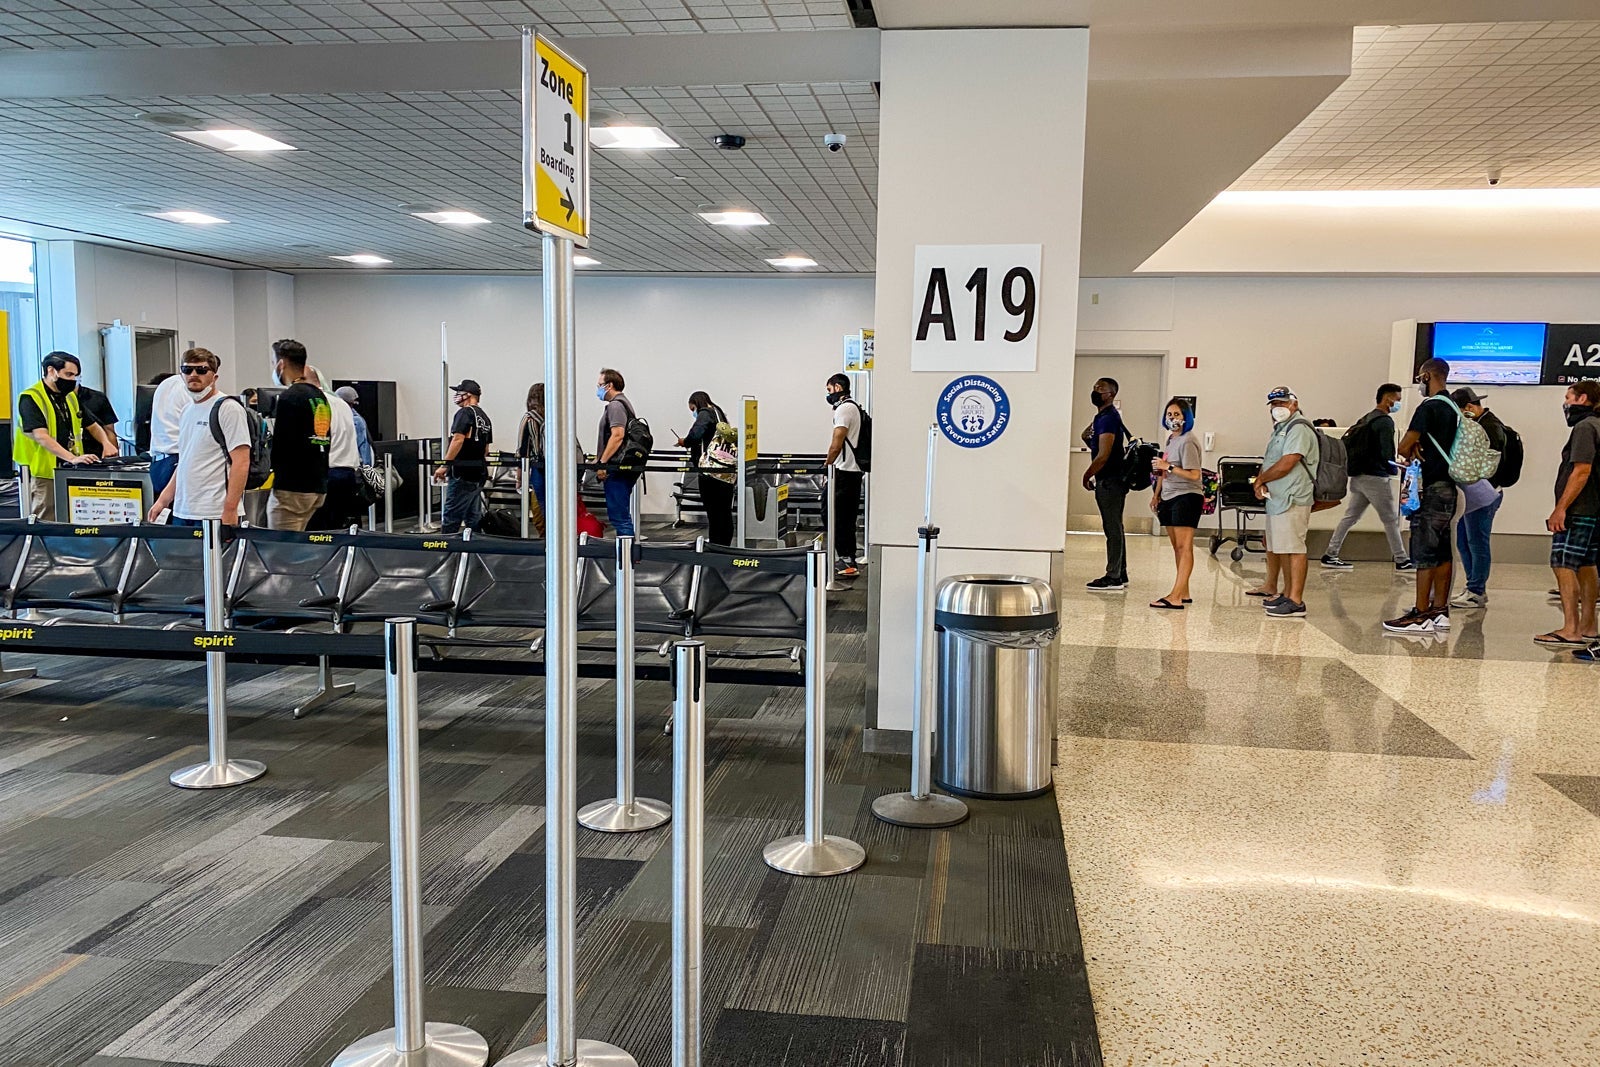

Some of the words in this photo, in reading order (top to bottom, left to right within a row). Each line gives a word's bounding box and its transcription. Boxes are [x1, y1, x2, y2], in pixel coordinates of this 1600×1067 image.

[540, 56, 574, 105] Zone
[563, 113, 574, 156] 1
[540, 147, 575, 183] Boarding
[915, 266, 1036, 343] A19
[943, 382, 964, 403] Social
[964, 379, 1002, 402] Distancing
[941, 412, 949, 425] for
[945, 425, 986, 443] Everyone's
[986, 412, 1007, 438] Safety!
[75, 527, 99, 535] spirit
[309, 534, 333, 542] spirit
[423, 540, 448, 548] spirit
[732, 558, 760, 567] spirit
[193, 634, 235, 648] spirit
